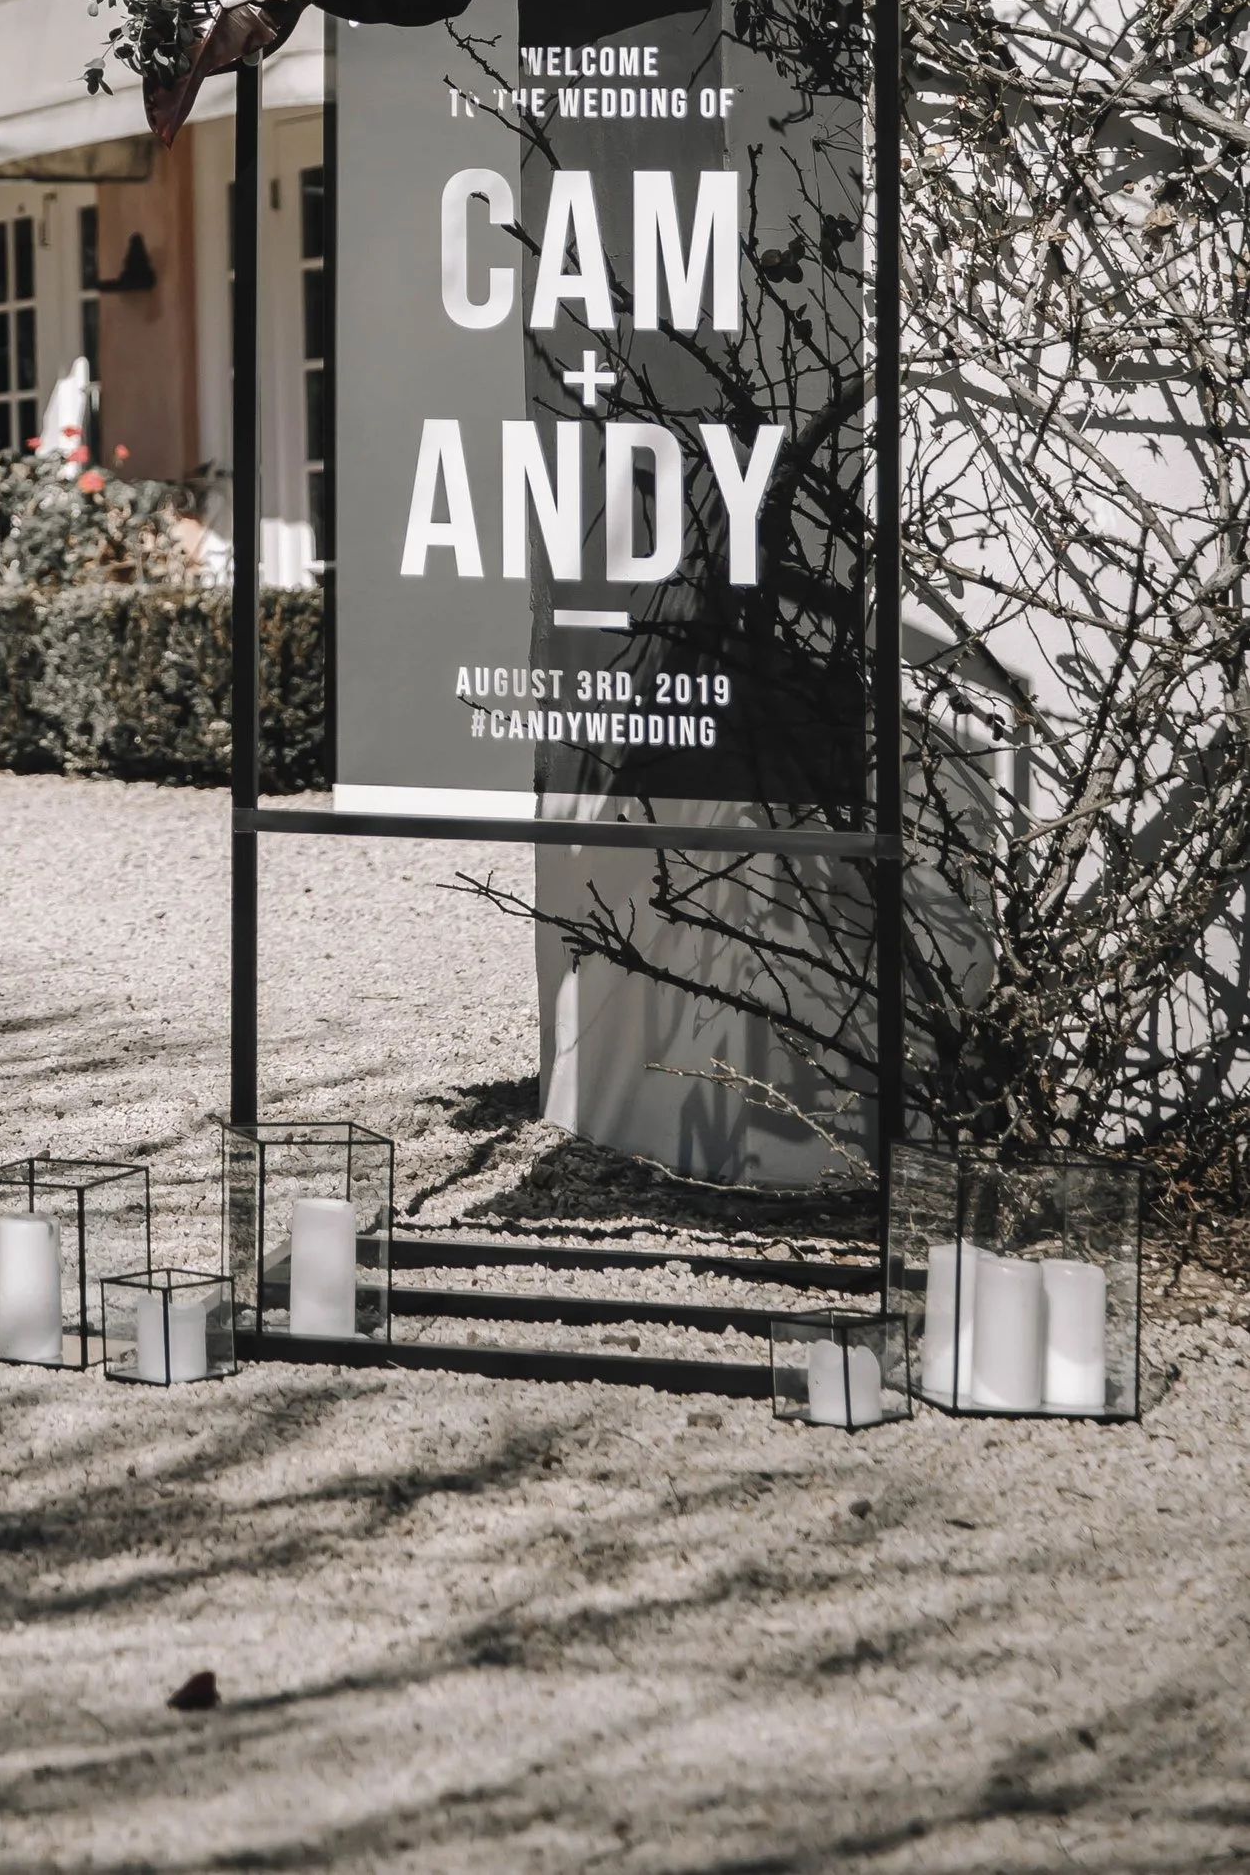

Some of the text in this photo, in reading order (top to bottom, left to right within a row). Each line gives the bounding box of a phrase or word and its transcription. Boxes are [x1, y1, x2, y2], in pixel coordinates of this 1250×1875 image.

[520, 45, 659, 77] WELCOME
[492, 88, 547, 119] THE
[557, 87, 689, 119] WEDDING
[699, 87, 735, 119] OF
[440, 167, 740, 331] CAM
[399, 417, 787, 586] ANDY
[455, 666, 731, 707] AUGUST 3RD, 2019
[470, 708, 717, 748] #CANDYWEDDING
